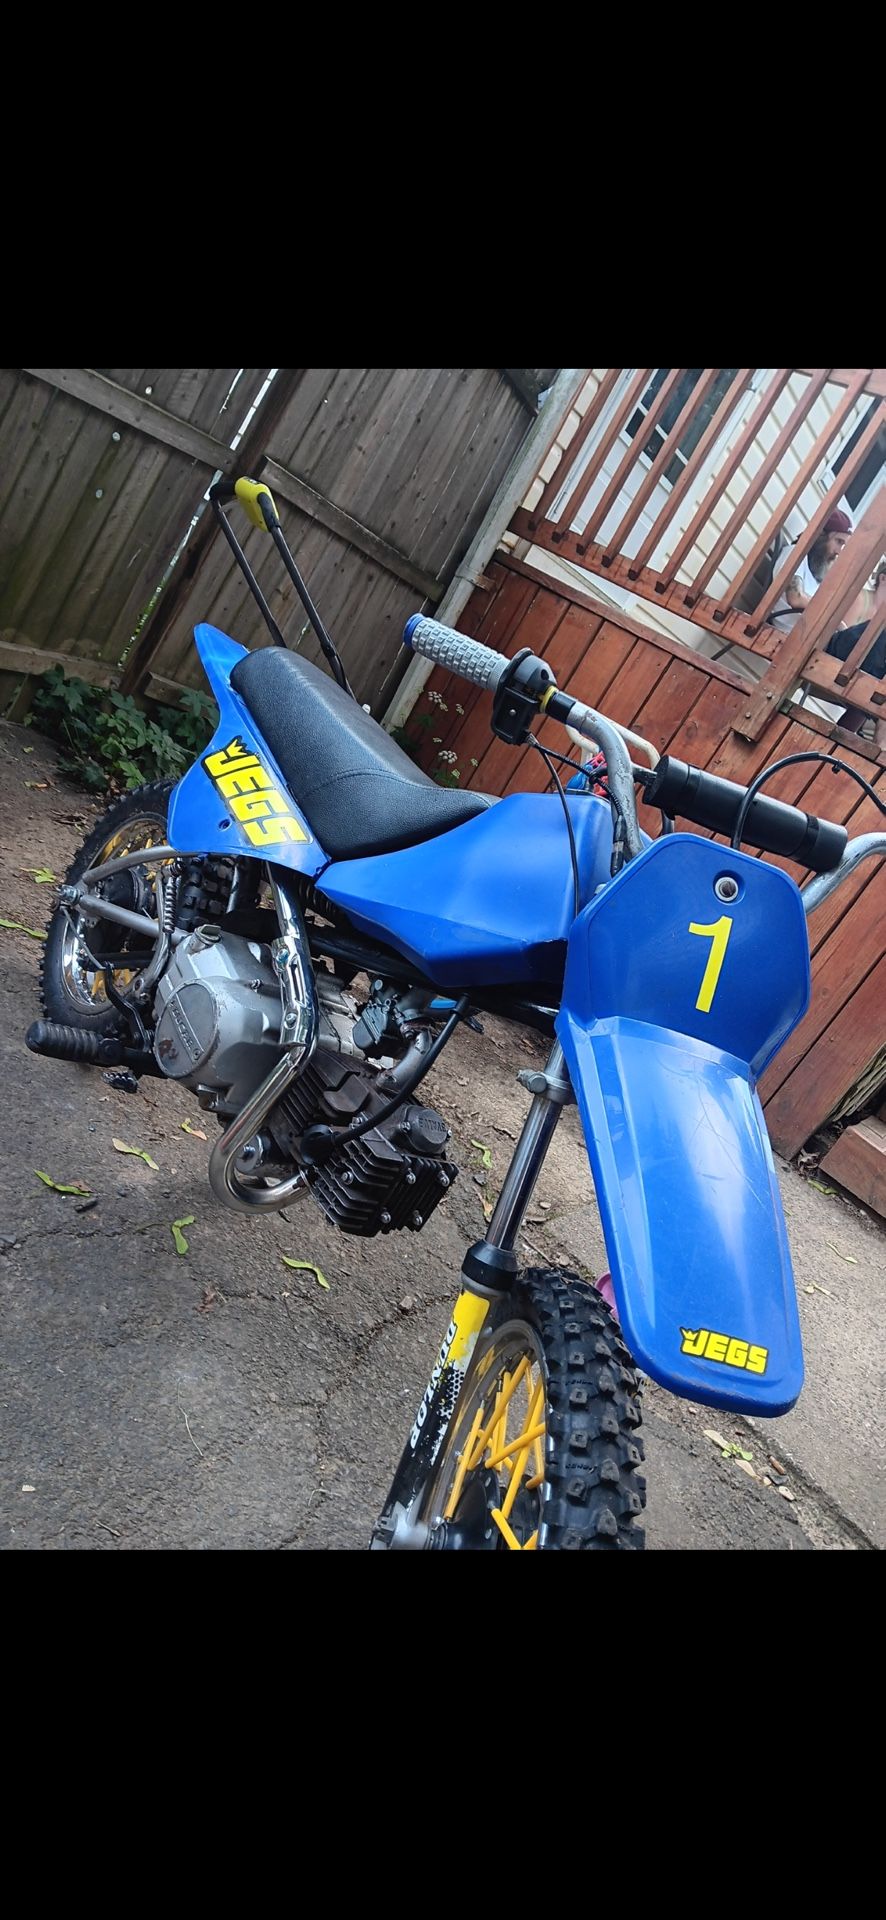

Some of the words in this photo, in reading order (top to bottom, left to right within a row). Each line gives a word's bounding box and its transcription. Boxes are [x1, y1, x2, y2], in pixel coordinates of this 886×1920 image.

[203, 746, 309, 847] JEGS
[688, 915, 733, 1013] 1
[410, 1320, 457, 1449] DUNLOP
[681, 1329, 768, 1374] JEGS
